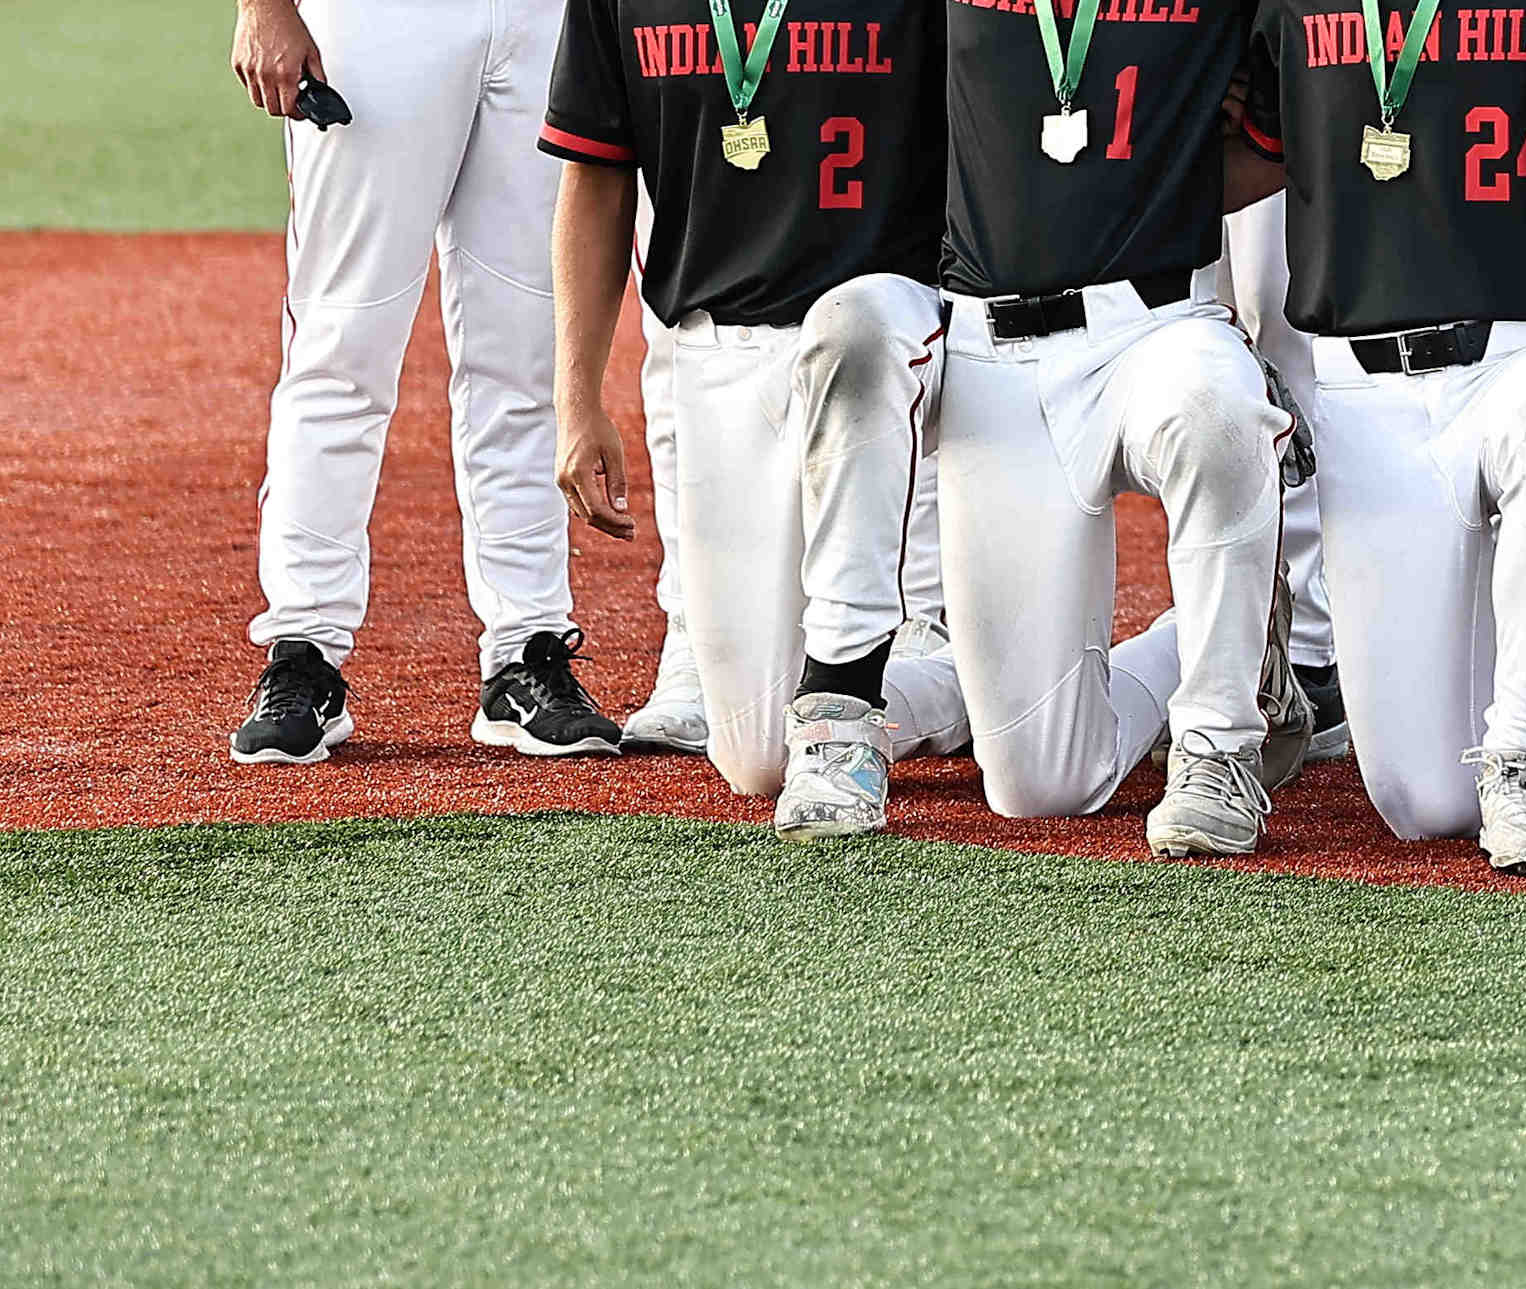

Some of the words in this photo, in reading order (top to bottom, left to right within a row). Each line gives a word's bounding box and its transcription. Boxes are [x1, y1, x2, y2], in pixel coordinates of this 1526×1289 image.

[787, 21, 892, 73] HILL
[725, 136, 768, 154] OHSAA
[1107, 66, 1139, 160] 1
[820, 118, 865, 209] 2
